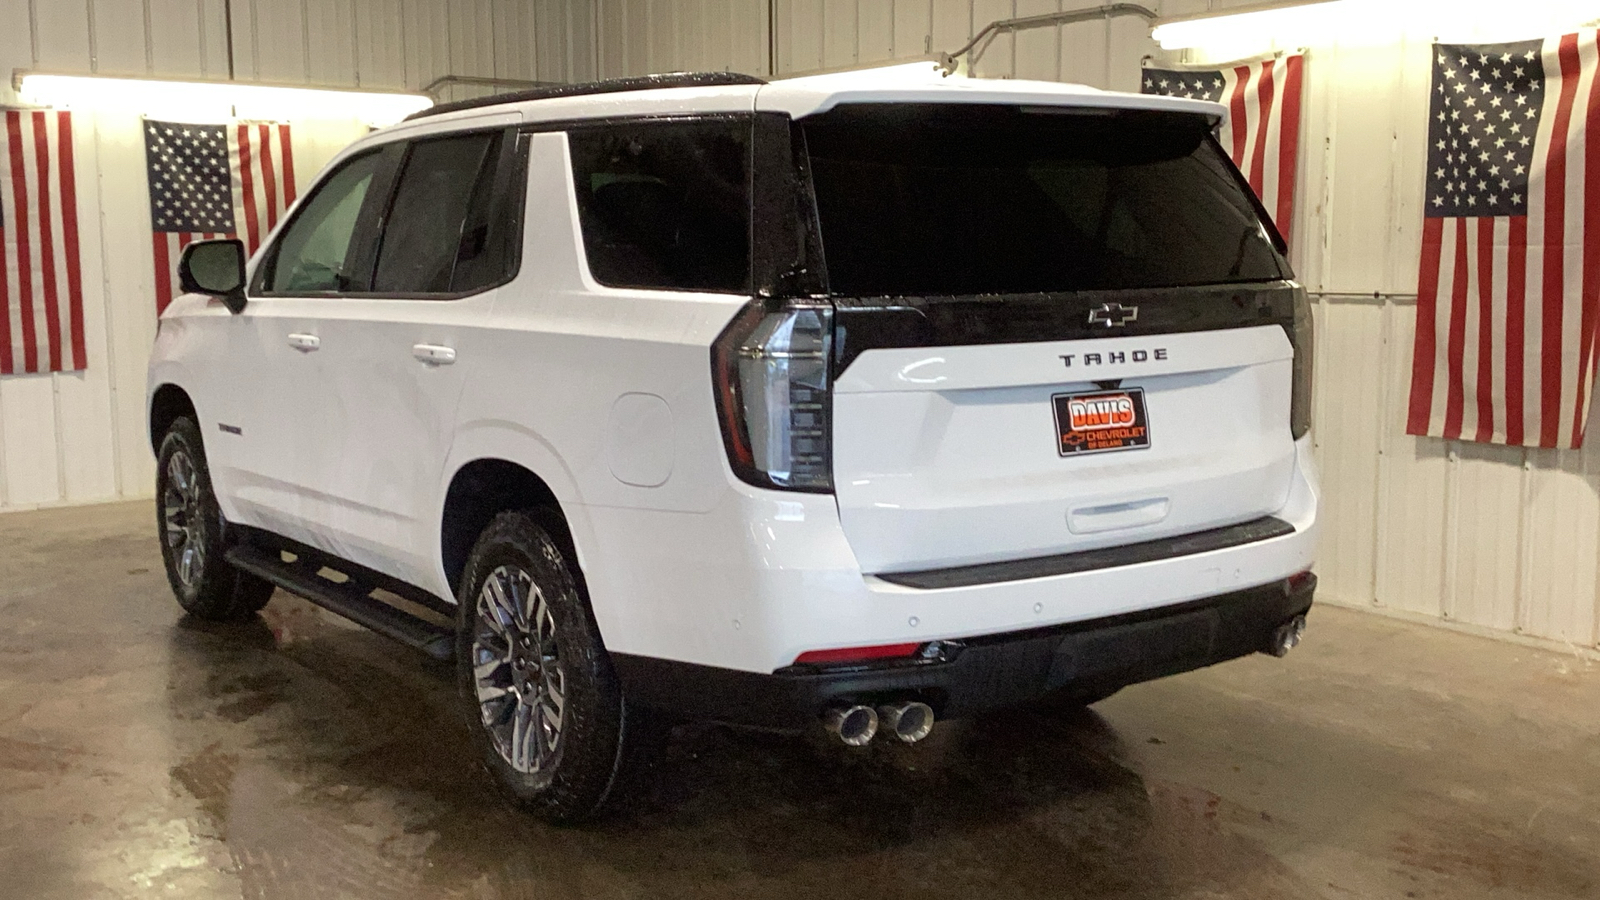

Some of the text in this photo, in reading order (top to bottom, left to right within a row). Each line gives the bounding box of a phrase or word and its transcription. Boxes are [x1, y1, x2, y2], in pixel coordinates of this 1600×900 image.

[1058, 348, 1168, 368] TAHOE
[1070, 398, 1134, 427] DAVIS
[1086, 427, 1145, 441] CHEVROLET
